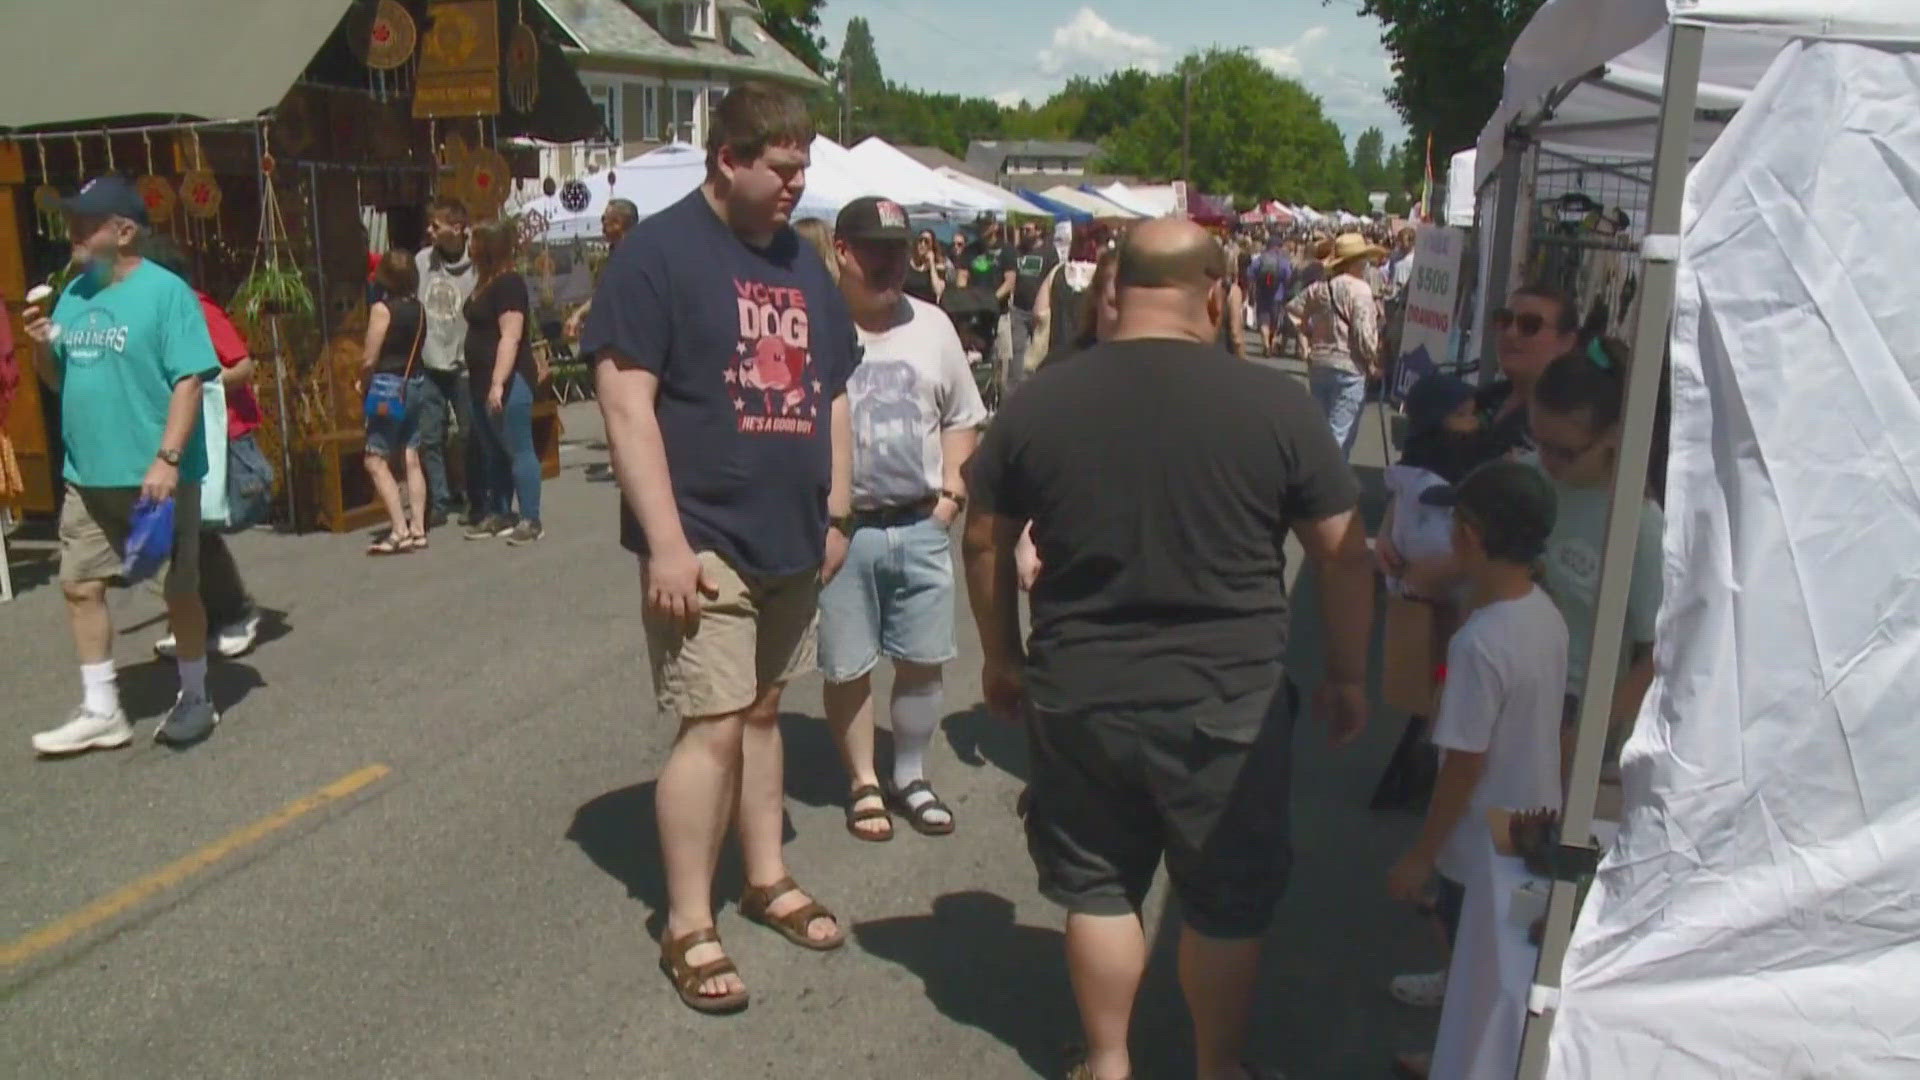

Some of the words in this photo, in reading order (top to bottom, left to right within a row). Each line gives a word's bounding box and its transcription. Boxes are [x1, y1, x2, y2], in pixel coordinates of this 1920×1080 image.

[733, 277, 806, 309] VOTE
[1416, 266, 1449, 295] $500
[737, 297, 808, 348] DOG
[764, 416, 773, 432] A
